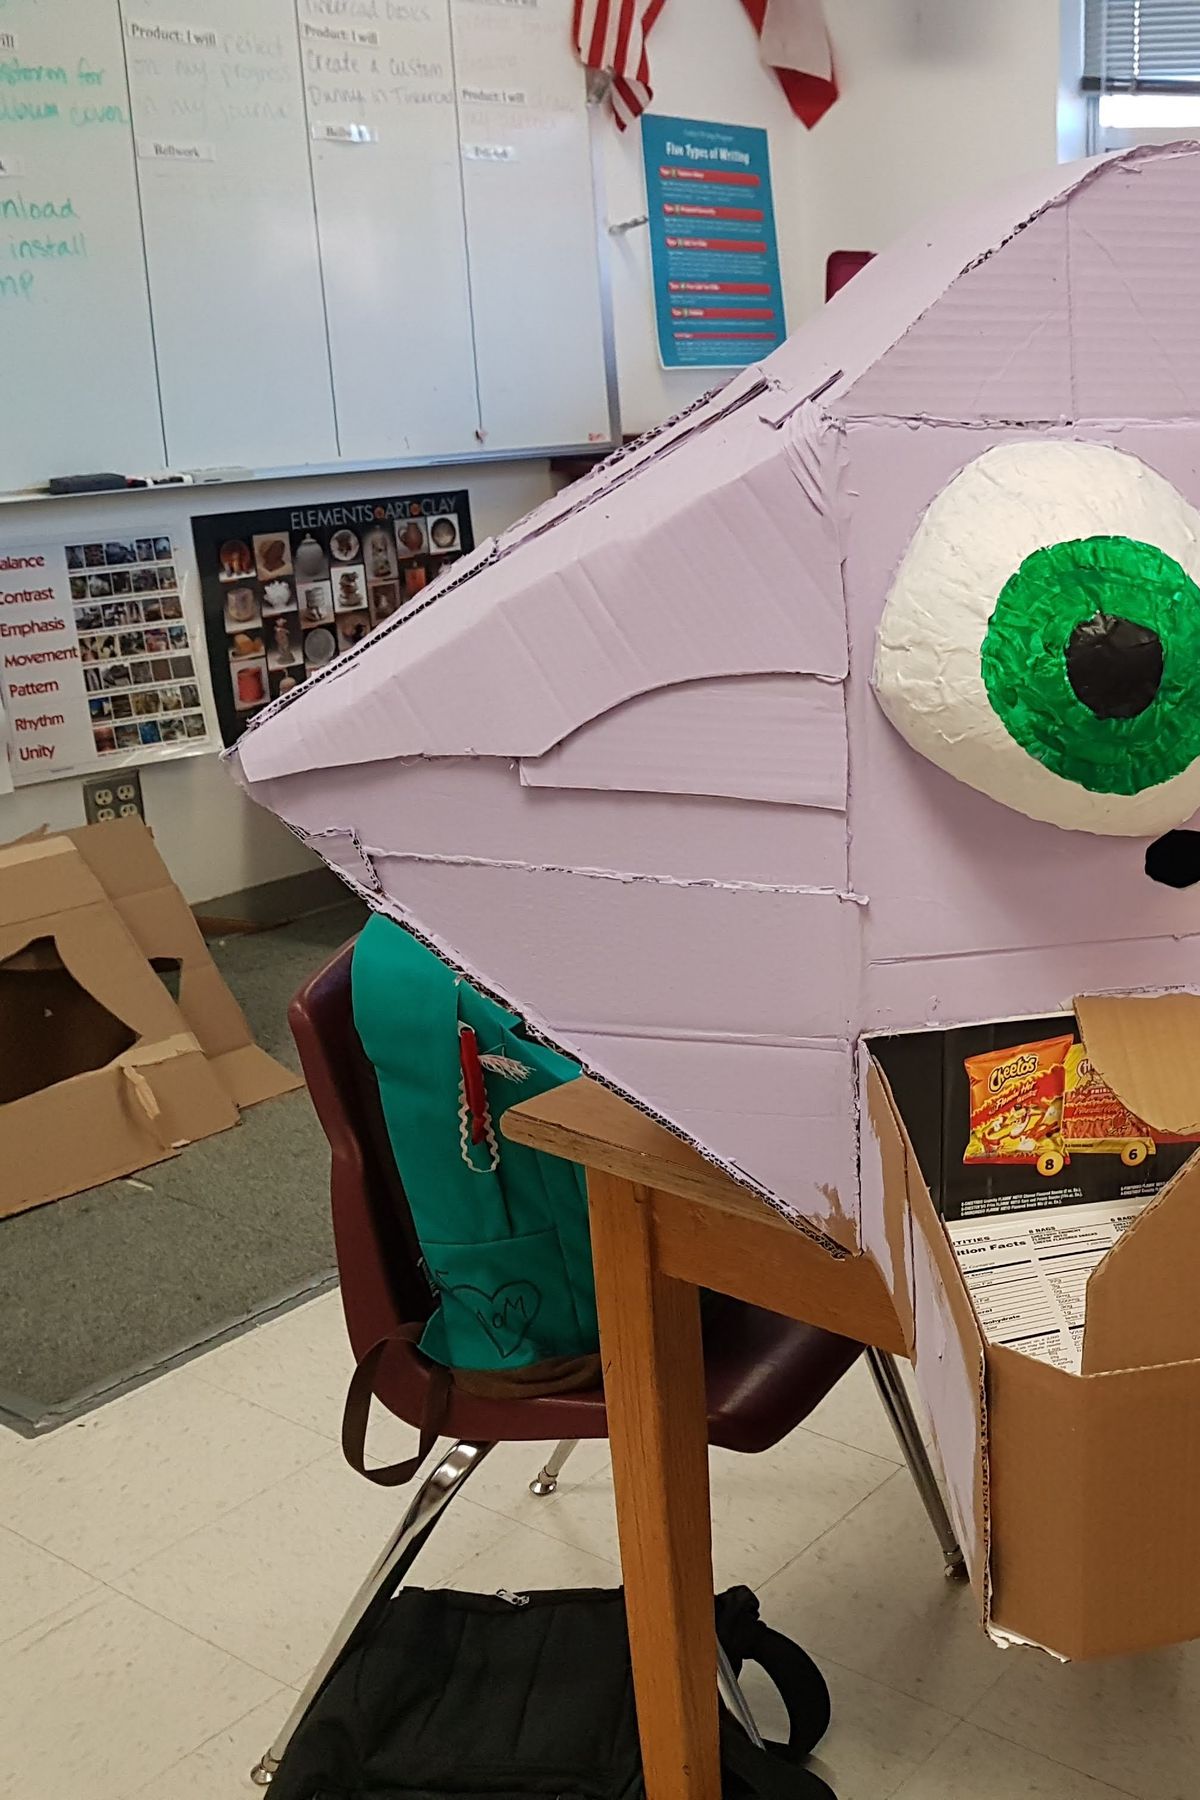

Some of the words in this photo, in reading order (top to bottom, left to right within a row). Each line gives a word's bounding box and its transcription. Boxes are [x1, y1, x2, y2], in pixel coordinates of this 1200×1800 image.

[131, 23, 183, 43] Product:
[290, 504, 375, 530] ELEMENTS
[386, 502, 411, 520] ART
[421, 496, 457, 516] CLAY
[0, 617, 66, 638] Emphasis
[4, 646, 79, 668] Movement
[9, 680, 60, 698] Pattern
[15, 713, 65, 732] Rhythm
[20, 745, 56, 761] Unity
[988, 1053, 1039, 1095] Cheetos
[1129, 1149, 1138, 1160] 6
[1045, 1159, 1055, 1170] 8
[953, 1235, 991, 1246] TITIES
[956, 1247, 987, 1257] ition
[989, 1240, 1027, 1251] Facts
